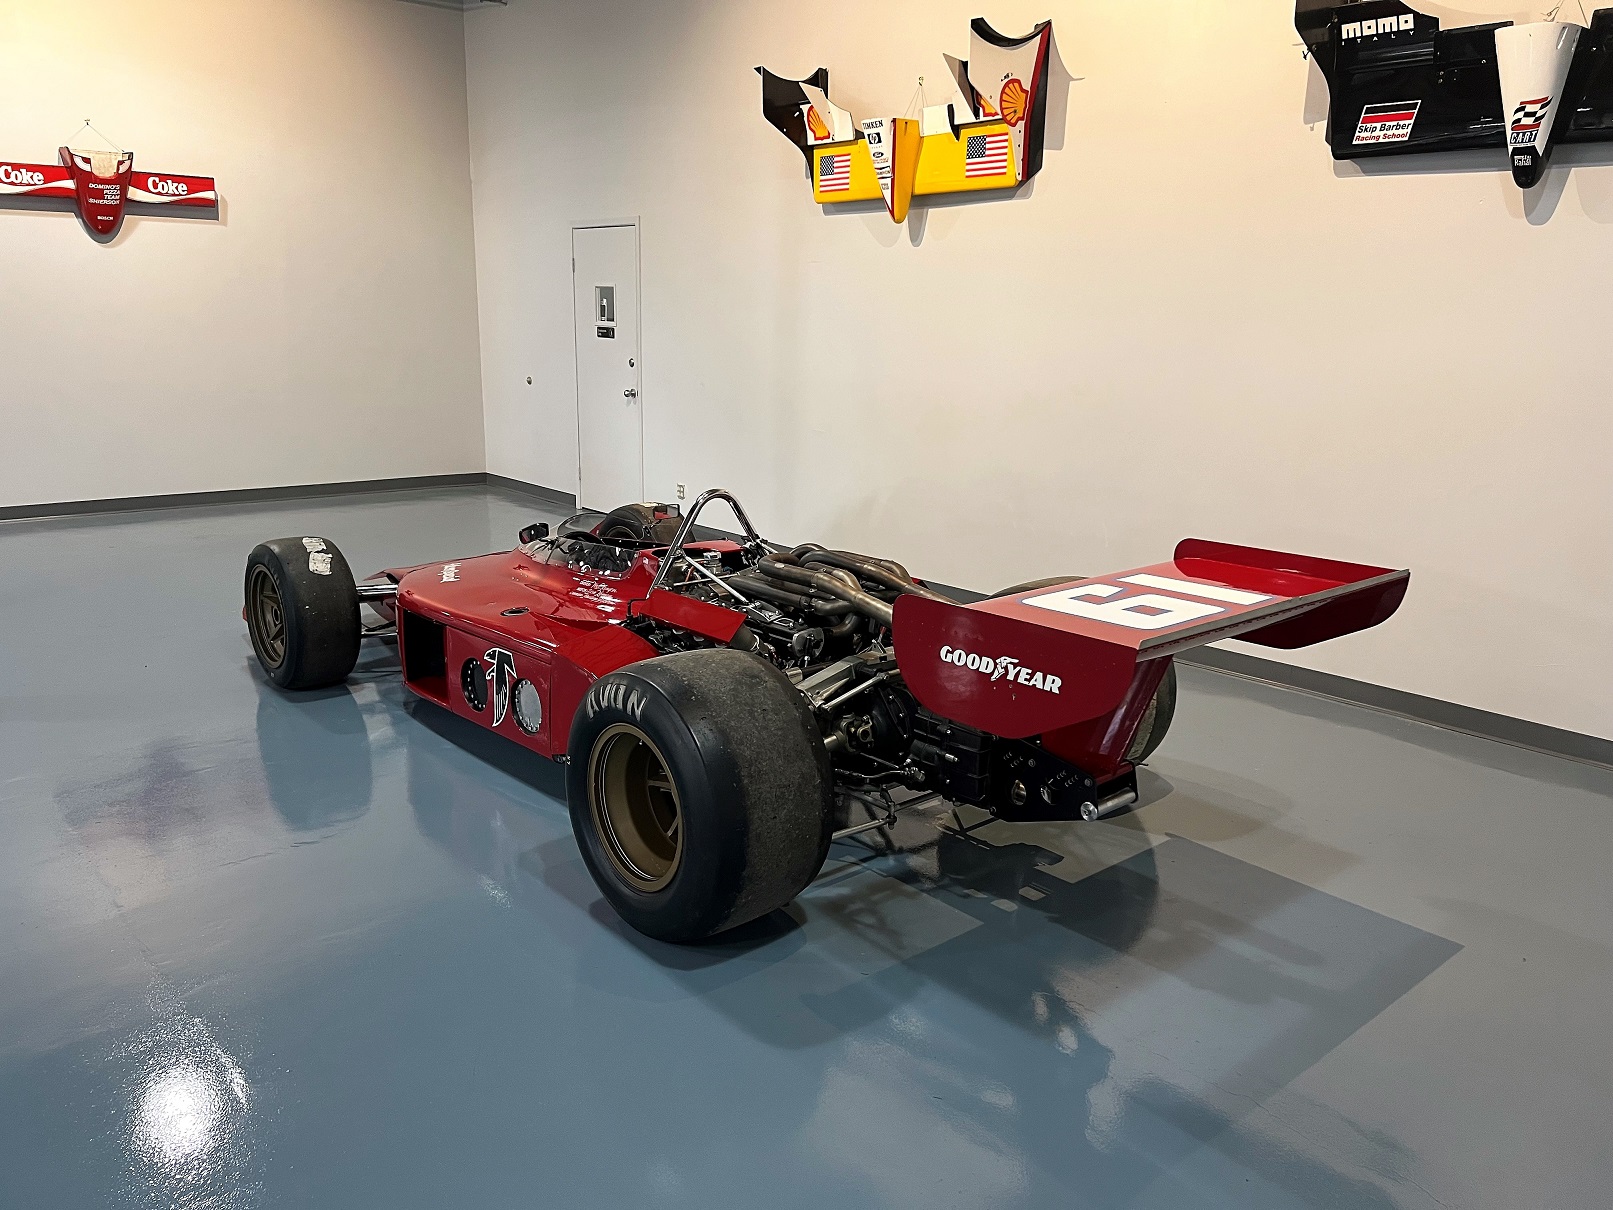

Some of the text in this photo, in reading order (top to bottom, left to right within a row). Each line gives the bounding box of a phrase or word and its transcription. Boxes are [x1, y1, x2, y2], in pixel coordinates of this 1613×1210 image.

[1342, 30, 1415, 46] ITALY
[1357, 121, 1412, 134] Skip Barber
[1354, 131, 1409, 143] Racing School
[0, 165, 44, 185] Coke
[148, 177, 188, 195] Coke
[939, 644, 1063, 695] GOODYEAR
